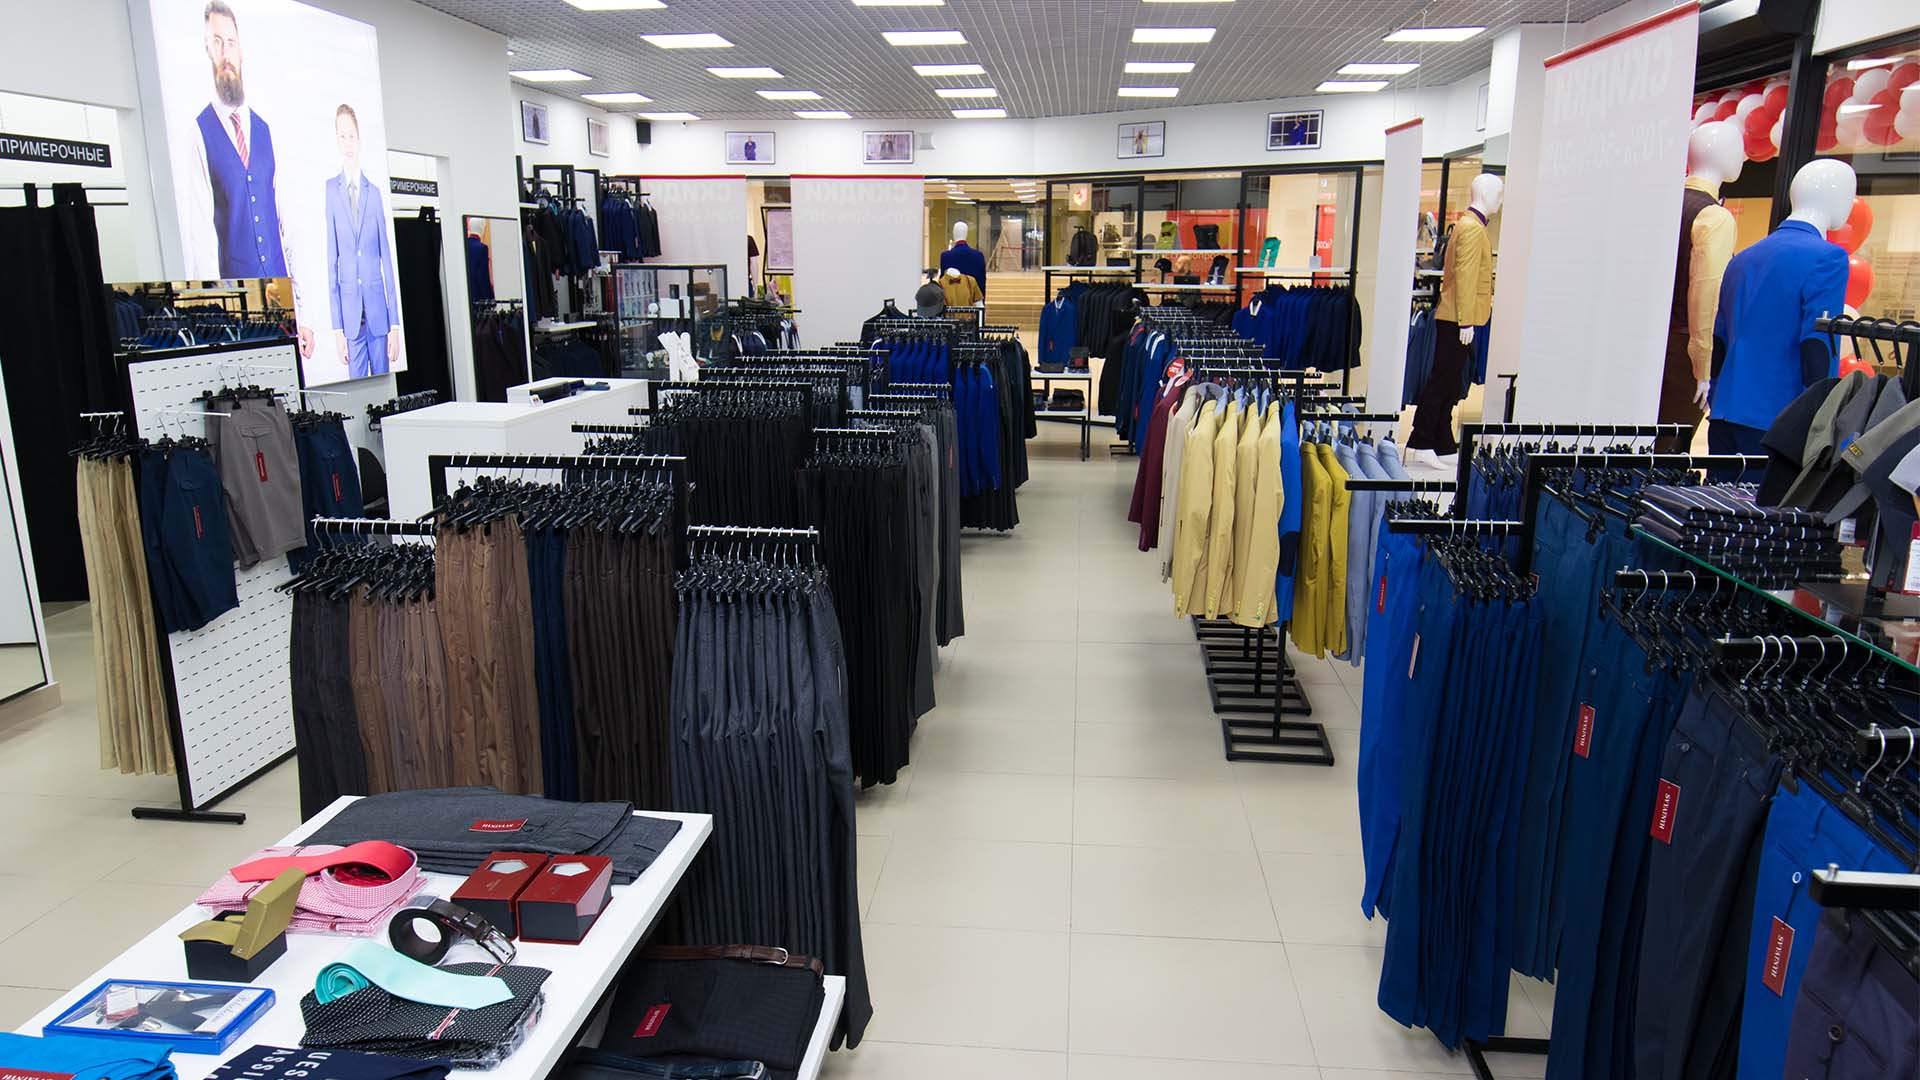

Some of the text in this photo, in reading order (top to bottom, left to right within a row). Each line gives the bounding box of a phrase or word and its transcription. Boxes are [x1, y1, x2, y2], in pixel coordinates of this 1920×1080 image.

[0, 138, 105, 162] ПРИМЕРОЧНЫЕ
[233, 1049, 295, 1080] ASSI
[279, 1051, 332, 1080] UES
